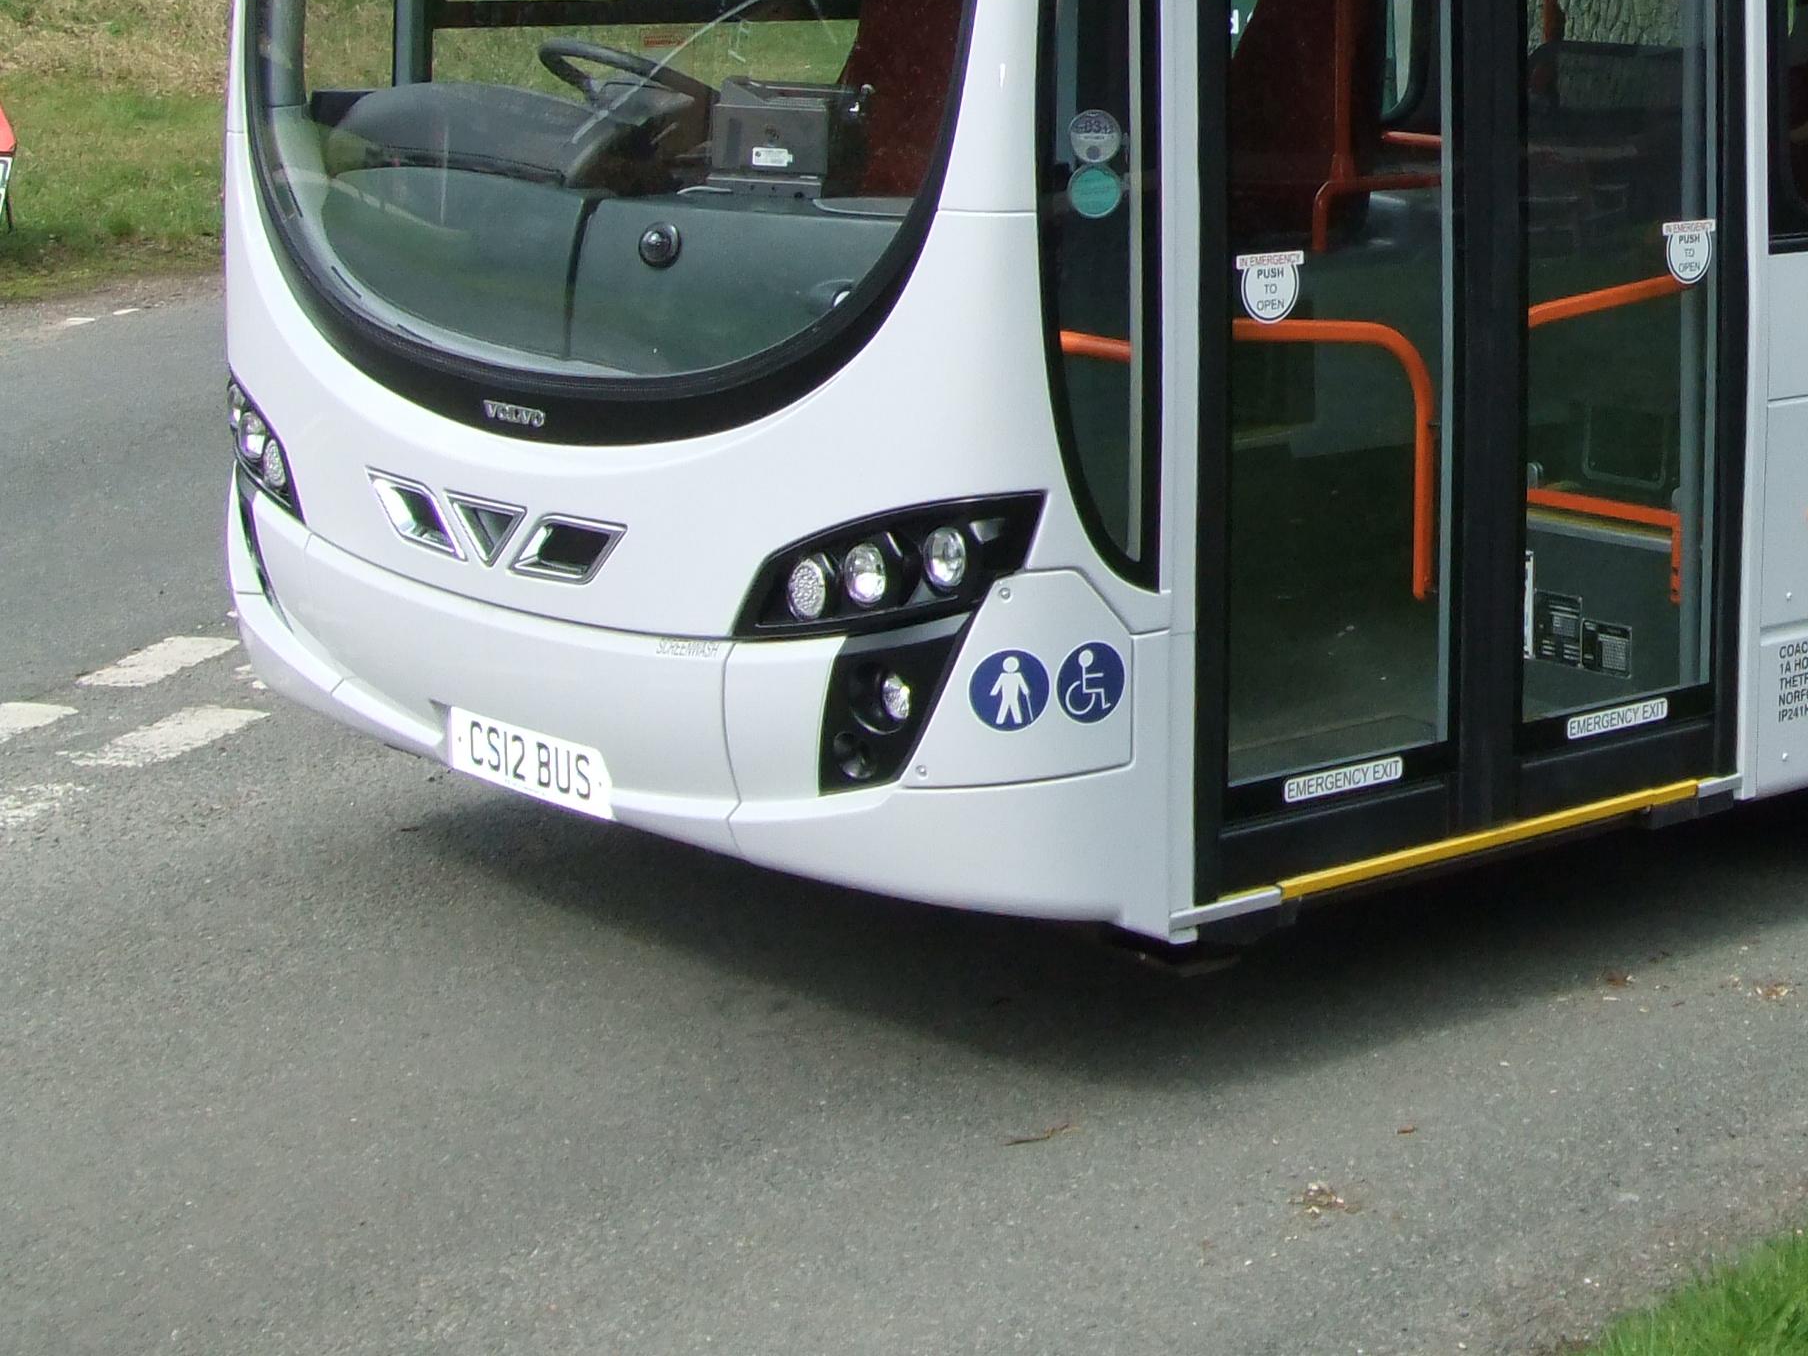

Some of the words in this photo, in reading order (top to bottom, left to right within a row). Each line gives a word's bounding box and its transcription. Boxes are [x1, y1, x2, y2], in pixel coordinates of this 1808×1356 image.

[1678, 233, 1701, 244] PUSH
[1249, 252, 1301, 266] EMERGENCY
[1256, 267, 1285, 279] PUSH
[1678, 261, 1701, 273] OPEN
[1264, 283, 1278, 294] TO
[1256, 299, 1285, 312] OPEN
[482, 399, 545, 428] VOLVO
[1780, 660, 1792, 675] 1A
[1569, 707, 1640, 737] EMERGENCY
[1641, 699, 1667, 720] EXIT
[469, 720, 526, 782] CS12
[536, 740, 592, 801] BUS
[1287, 765, 1369, 800] EMERGENCY
[1372, 759, 1401, 781] EXIT
